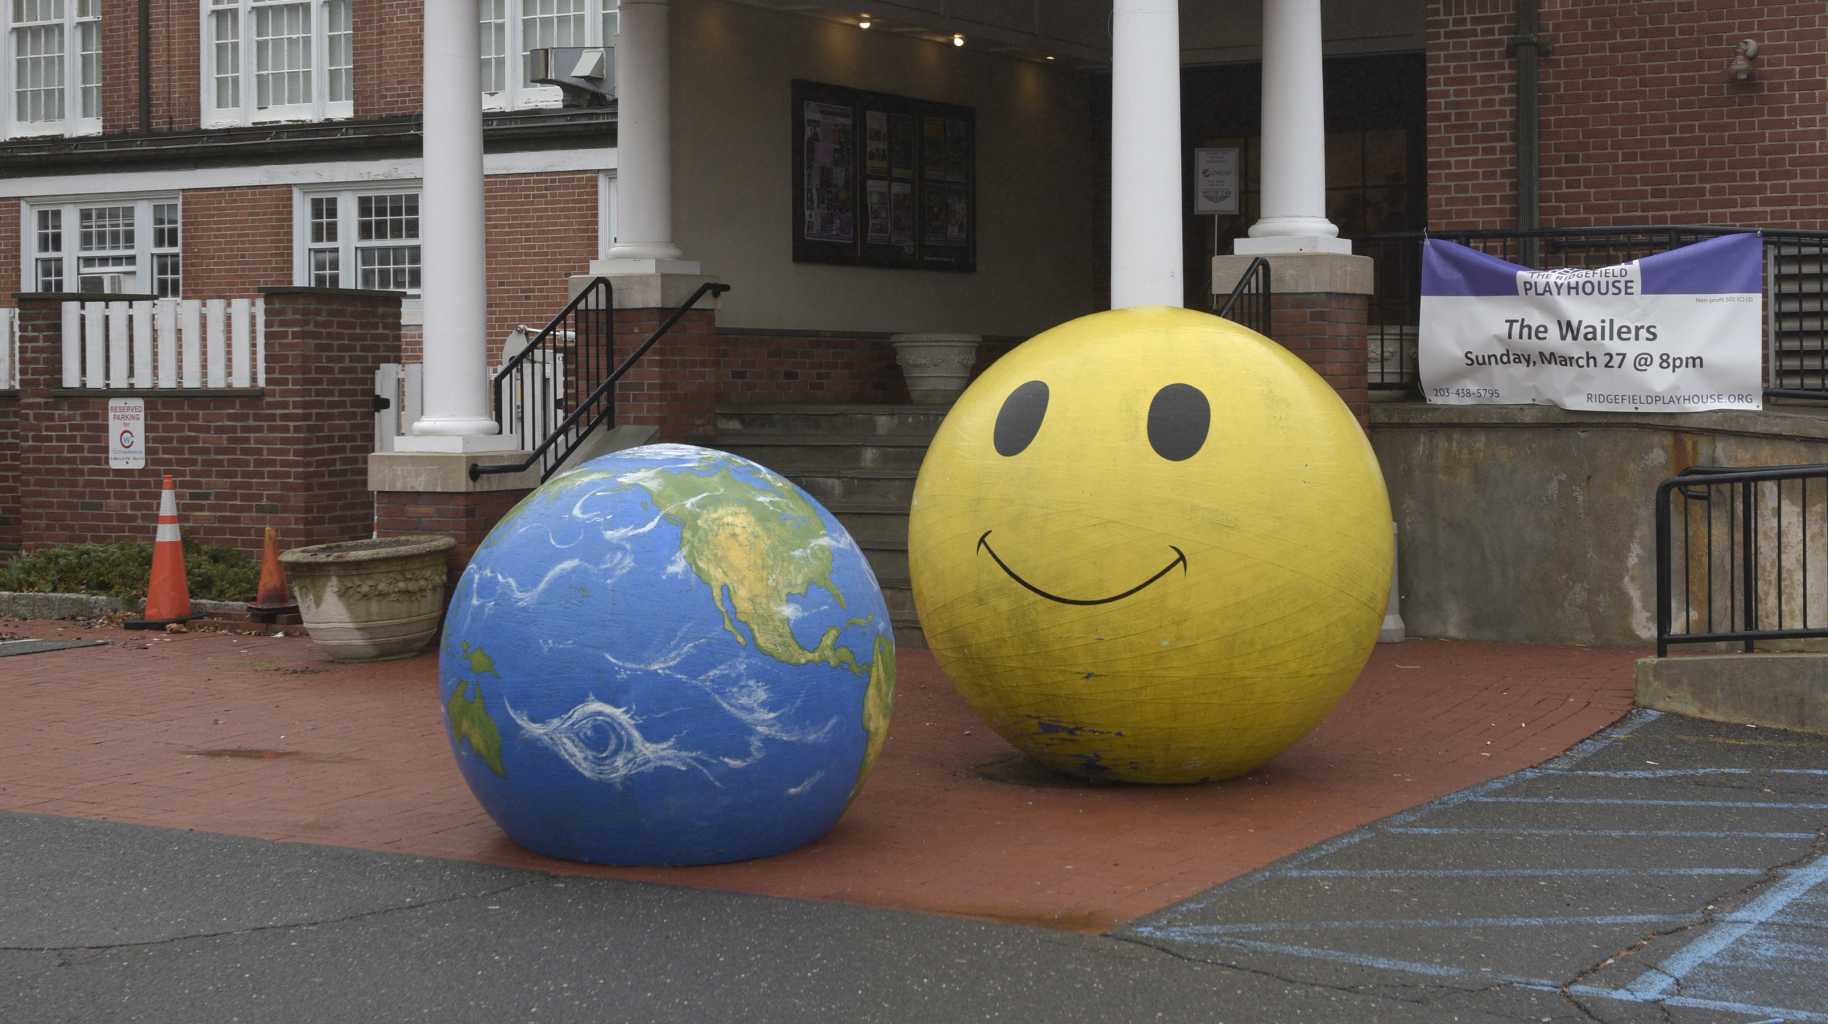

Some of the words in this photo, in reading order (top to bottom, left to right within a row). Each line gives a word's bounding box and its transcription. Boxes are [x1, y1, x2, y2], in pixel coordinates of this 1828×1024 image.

[1523, 279, 1635, 296] PLAYHOUSE
[1505, 318, 1548, 341] The
[1557, 318, 1658, 342] Wailers
[1464, 348, 1537, 368] Sunday,
[1538, 351, 1597, 368] March
[1603, 352, 1627, 369] 27
[1633, 352, 1654, 372] @
[1658, 352, 1704, 373] 8pm
